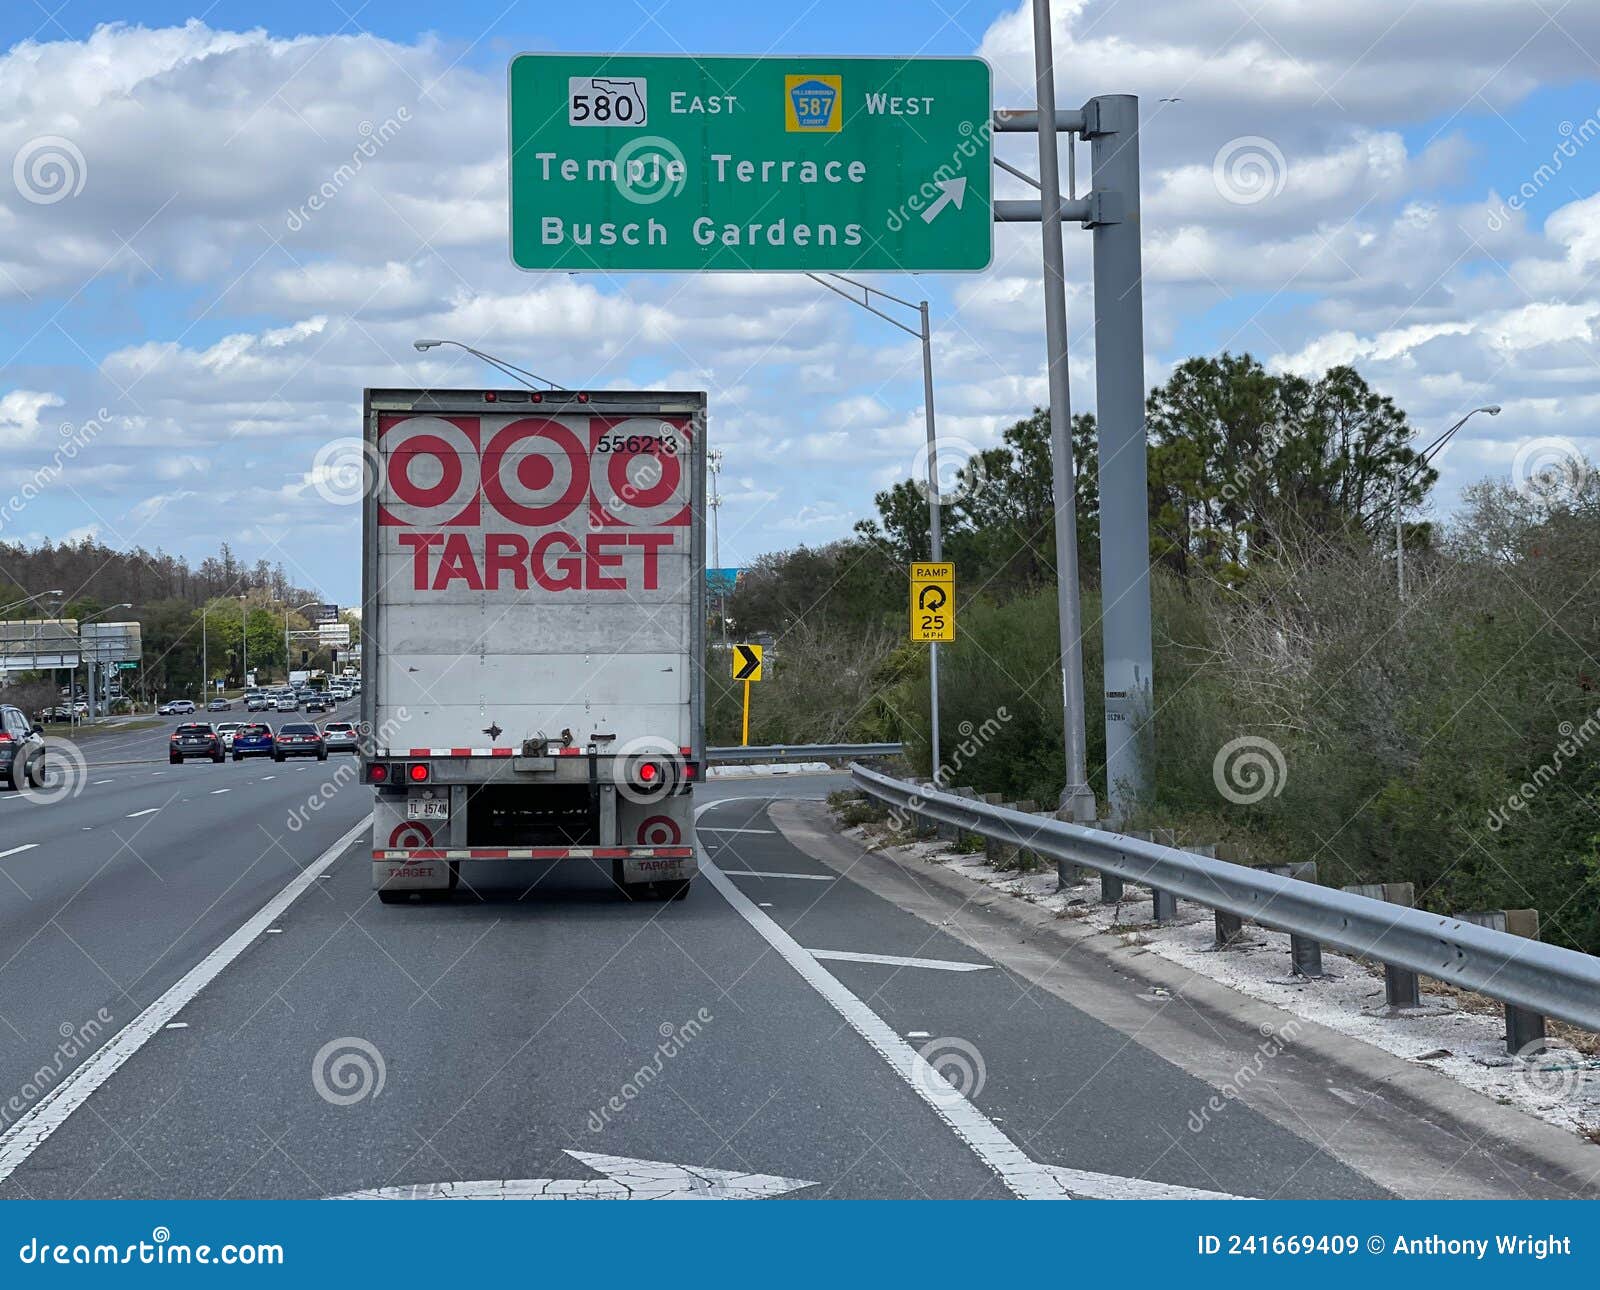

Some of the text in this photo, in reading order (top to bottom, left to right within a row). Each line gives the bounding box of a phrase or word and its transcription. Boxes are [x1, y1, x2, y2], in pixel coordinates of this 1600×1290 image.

[572, 94, 634, 122] 580
[670, 91, 737, 115] EAST
[798, 97, 832, 117] 587
[865, 93, 935, 115] WEST
[535, 152, 867, 189] Temple Terrace
[540, 216, 863, 246] Busch Gardens
[596, 434, 679, 454] 556213
[398, 531, 674, 592] TARGET
[916, 568, 948, 577] RAMP
[921, 615, 945, 630] 25
[922, 631, 944, 639] MPH
[388, 867, 434, 878] TARGET
[637, 859, 682, 872] TARGET
